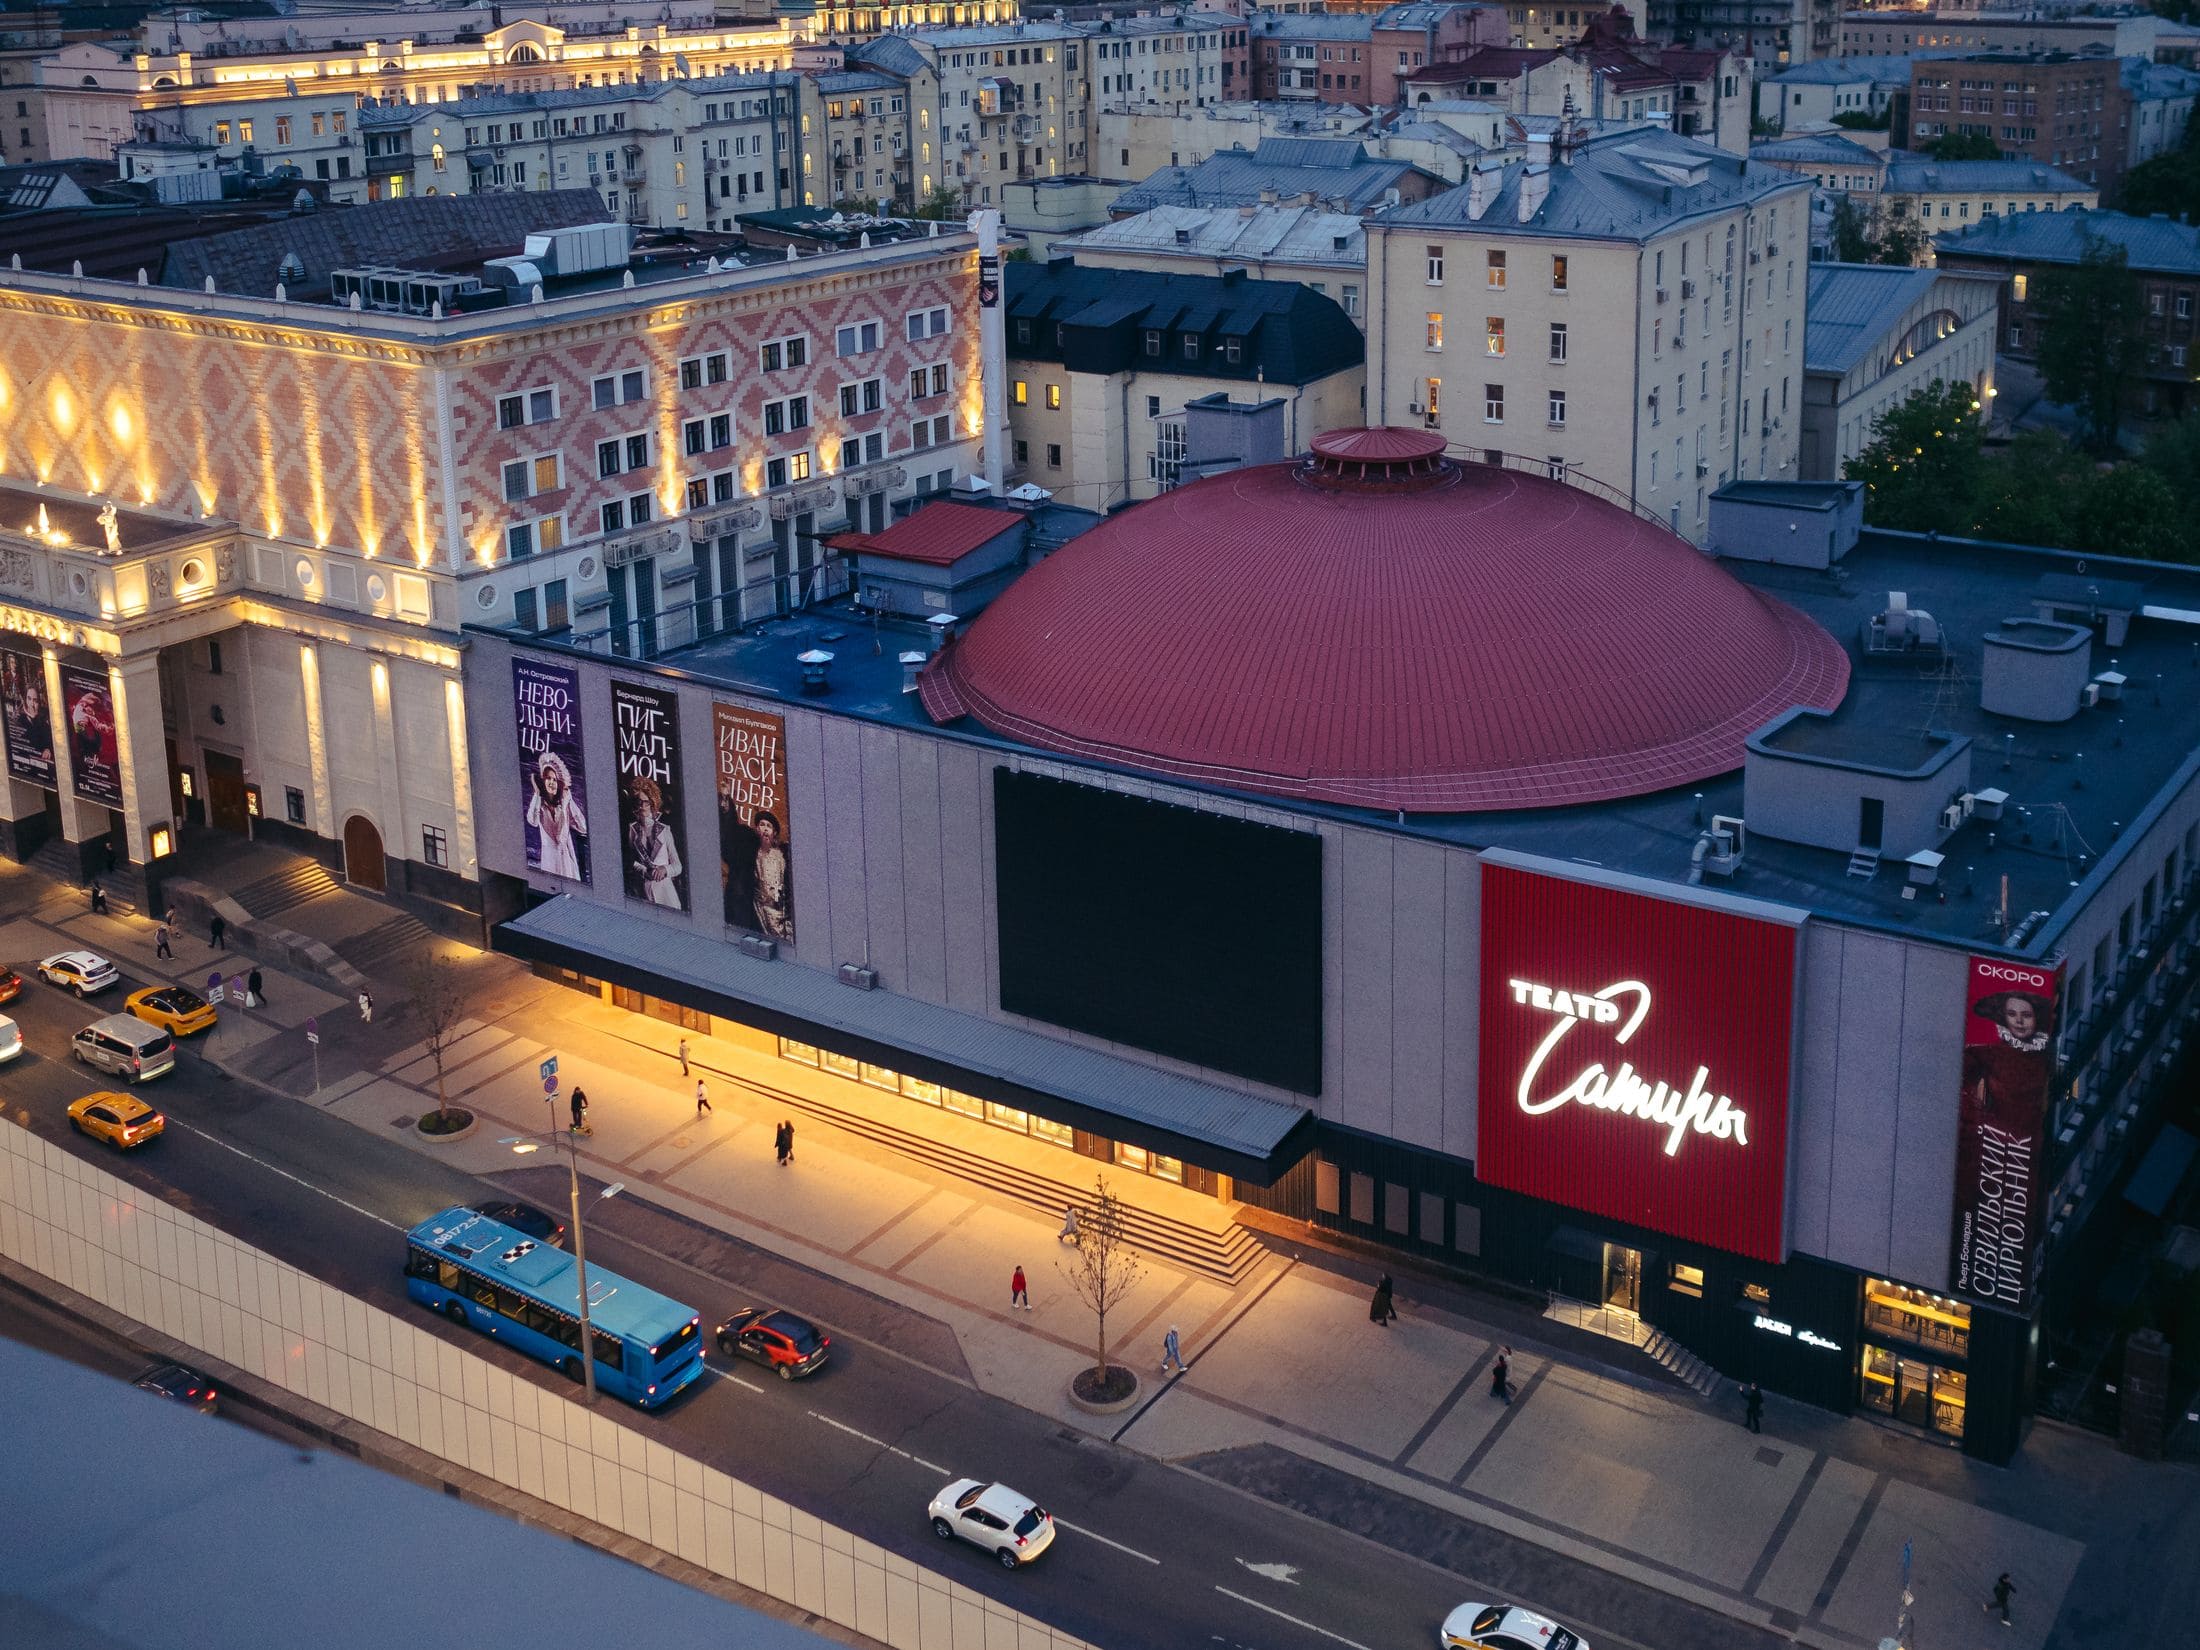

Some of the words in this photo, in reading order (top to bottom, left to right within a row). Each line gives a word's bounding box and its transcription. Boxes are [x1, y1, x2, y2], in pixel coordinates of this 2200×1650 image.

[530, 670, 569, 684] Островский
[519, 680, 574, 710] НЕВО-
[616, 689, 645, 703] Бернард
[645, 696, 659, 706] Шоу
[519, 703, 576, 735] ЛЬНИ-
[618, 702, 670, 732] ПИГ-
[718, 711, 745, 724] Михаил
[745, 718, 777, 731] Булгаков
[522, 728, 550, 754] ЦЫ
[620, 727, 673, 759] МАЛ-
[720, 725, 776, 760] ИВАН
[621, 751, 671, 785] ИОН
[721, 750, 784, 785] ВАСИ-
[1978, 963, 2045, 988] СКОРО
[1509, 978, 1619, 1023] ТЕАТР
[1972, 1123, 2007, 1296] СЕВИЛЬСКИЙ
[1997, 1132, 2032, 1304] ЦИРЮЛЬНИК
[1960, 1210, 1972, 1261] Бомарше
[1958, 1262, 1970, 1290] Пьер
